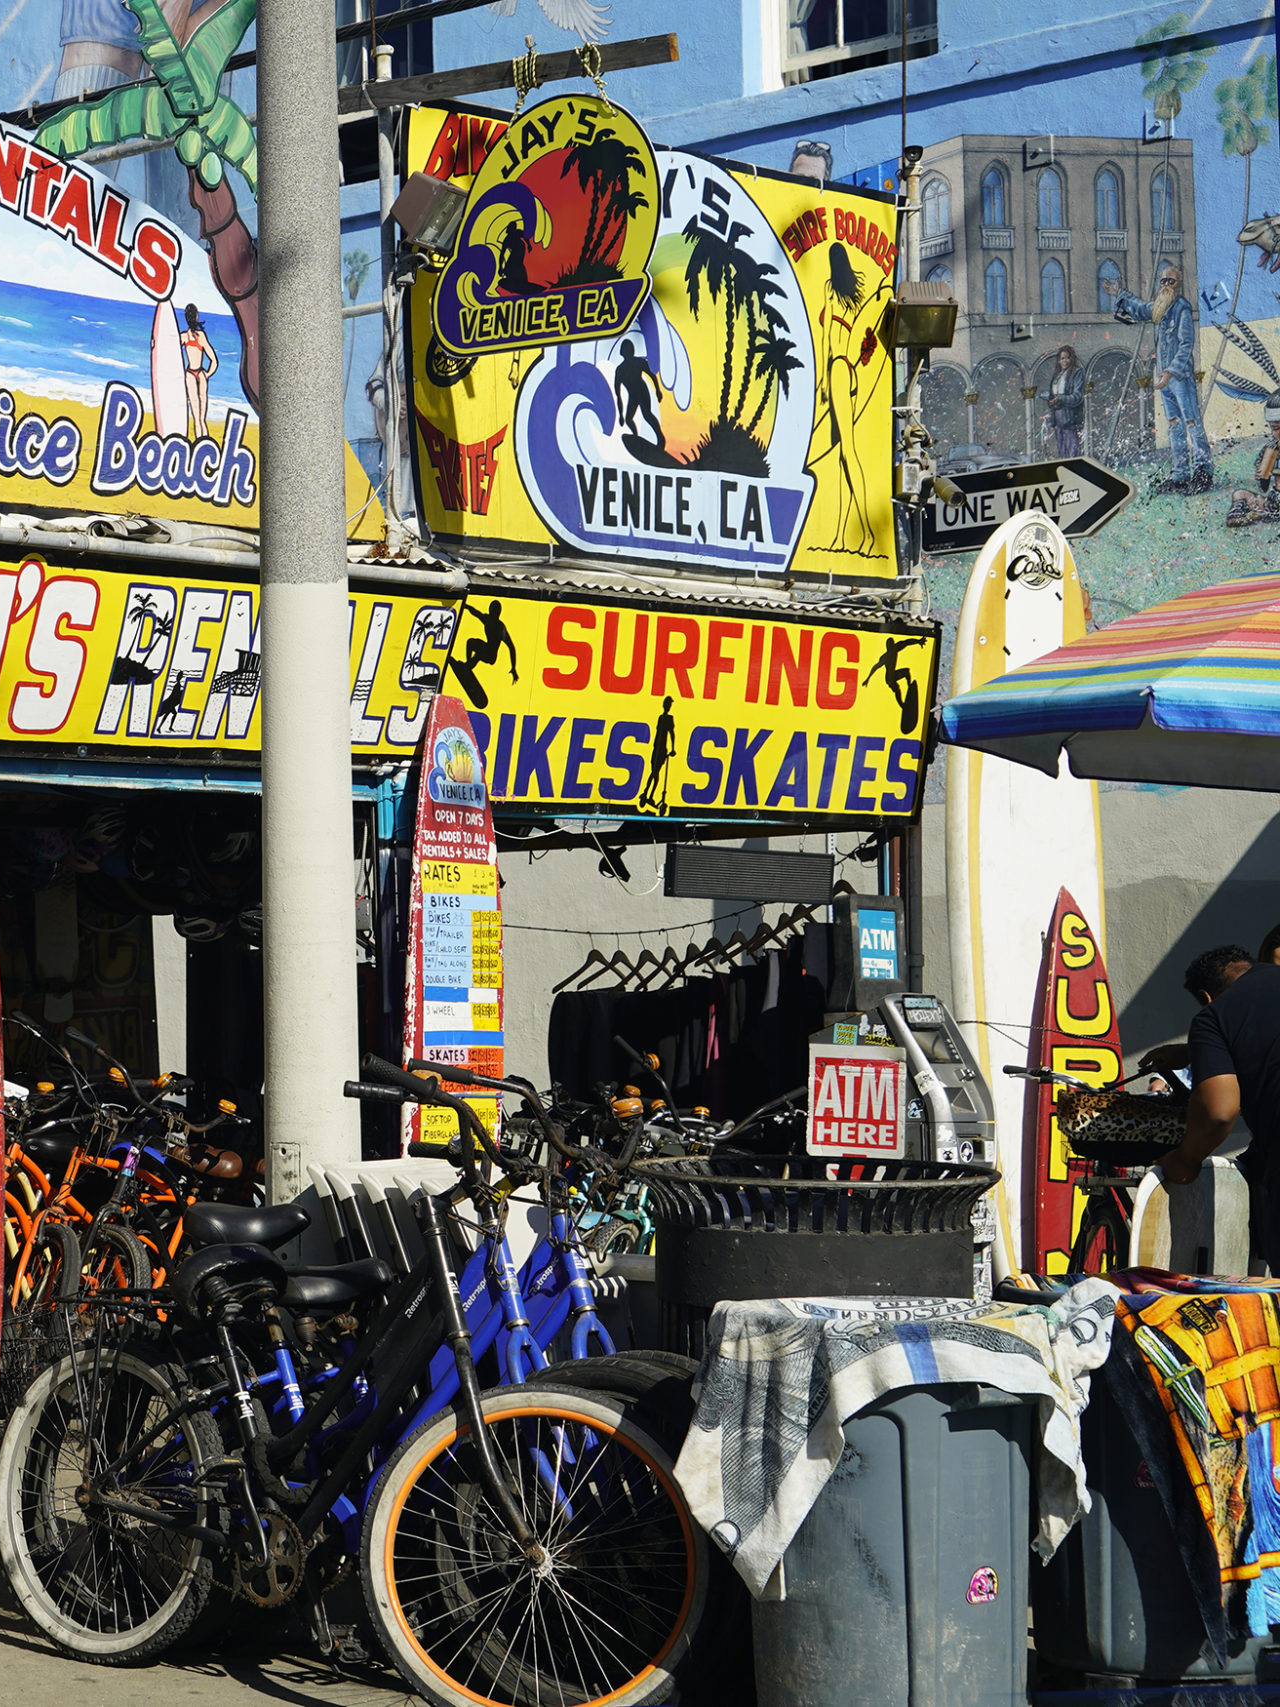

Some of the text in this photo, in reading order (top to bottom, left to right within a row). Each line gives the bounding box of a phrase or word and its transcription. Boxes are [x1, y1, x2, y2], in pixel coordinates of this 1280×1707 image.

[423, 113, 509, 181] BIK
[500, 101, 600, 180] JAY'S
[782, 206, 897, 276] SURF BOARDS
[459, 285, 620, 345] VENICE, CA
[90, 381, 256, 507] Beach
[577, 465, 764, 544] VENICE, CA
[942, 485, 1064, 527] ONE WAY
[94, 582, 458, 748] RENLS
[543, 606, 860, 711] SURFING
[680, 725, 922, 813] SKATES
[422, 830, 488, 846] TAX ADDED TO ALL
[435, 809, 484, 827] OPEN 7 DAYS
[422, 844, 487, 861] RENTALS + SALES
[424, 863, 461, 882] RATES
[430, 896, 461, 908] BIKES
[860, 928, 896, 951] ATM
[432, 1005, 455, 1016] WHEEL
[429, 1049, 466, 1063] SKATES
[814, 1064, 896, 1122] ATM
[426, 1114, 452, 1125] SOFTOP
[817, 1121, 897, 1147] HERE
